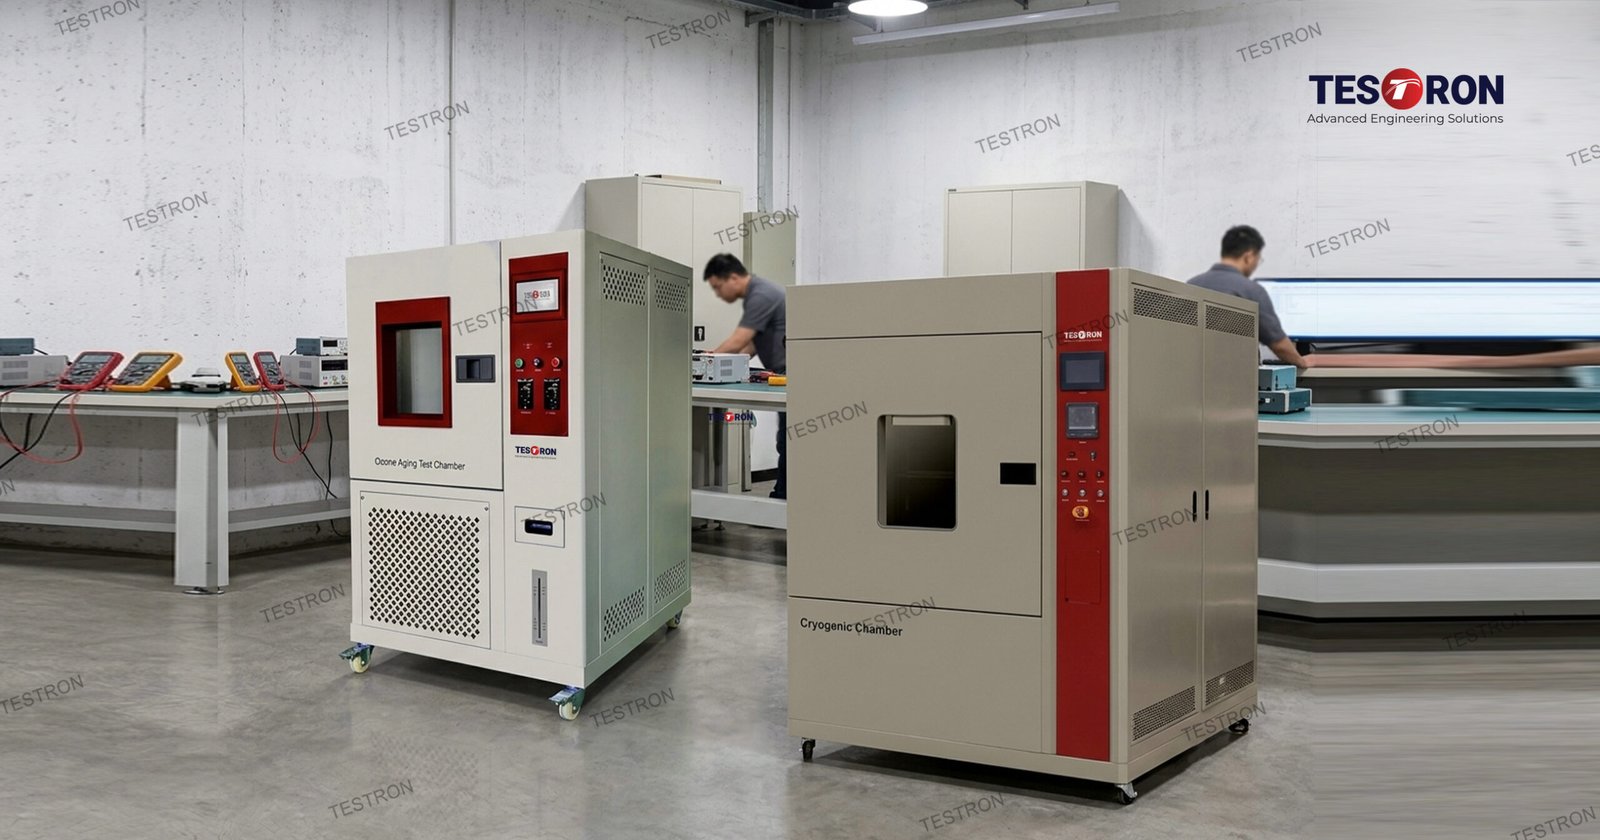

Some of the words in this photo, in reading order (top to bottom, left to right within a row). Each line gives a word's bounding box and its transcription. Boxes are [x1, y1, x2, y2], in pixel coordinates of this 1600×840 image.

[1063, 330, 1103, 339] TESTRON
[515, 445, 557, 456] TESTRON
[398, 458, 418, 470] Aging
[419, 459, 433, 469] Test
[433, 460, 466, 471] Chamber
[800, 617, 853, 632] Cryogenic
[855, 622, 904, 637] Chamber
